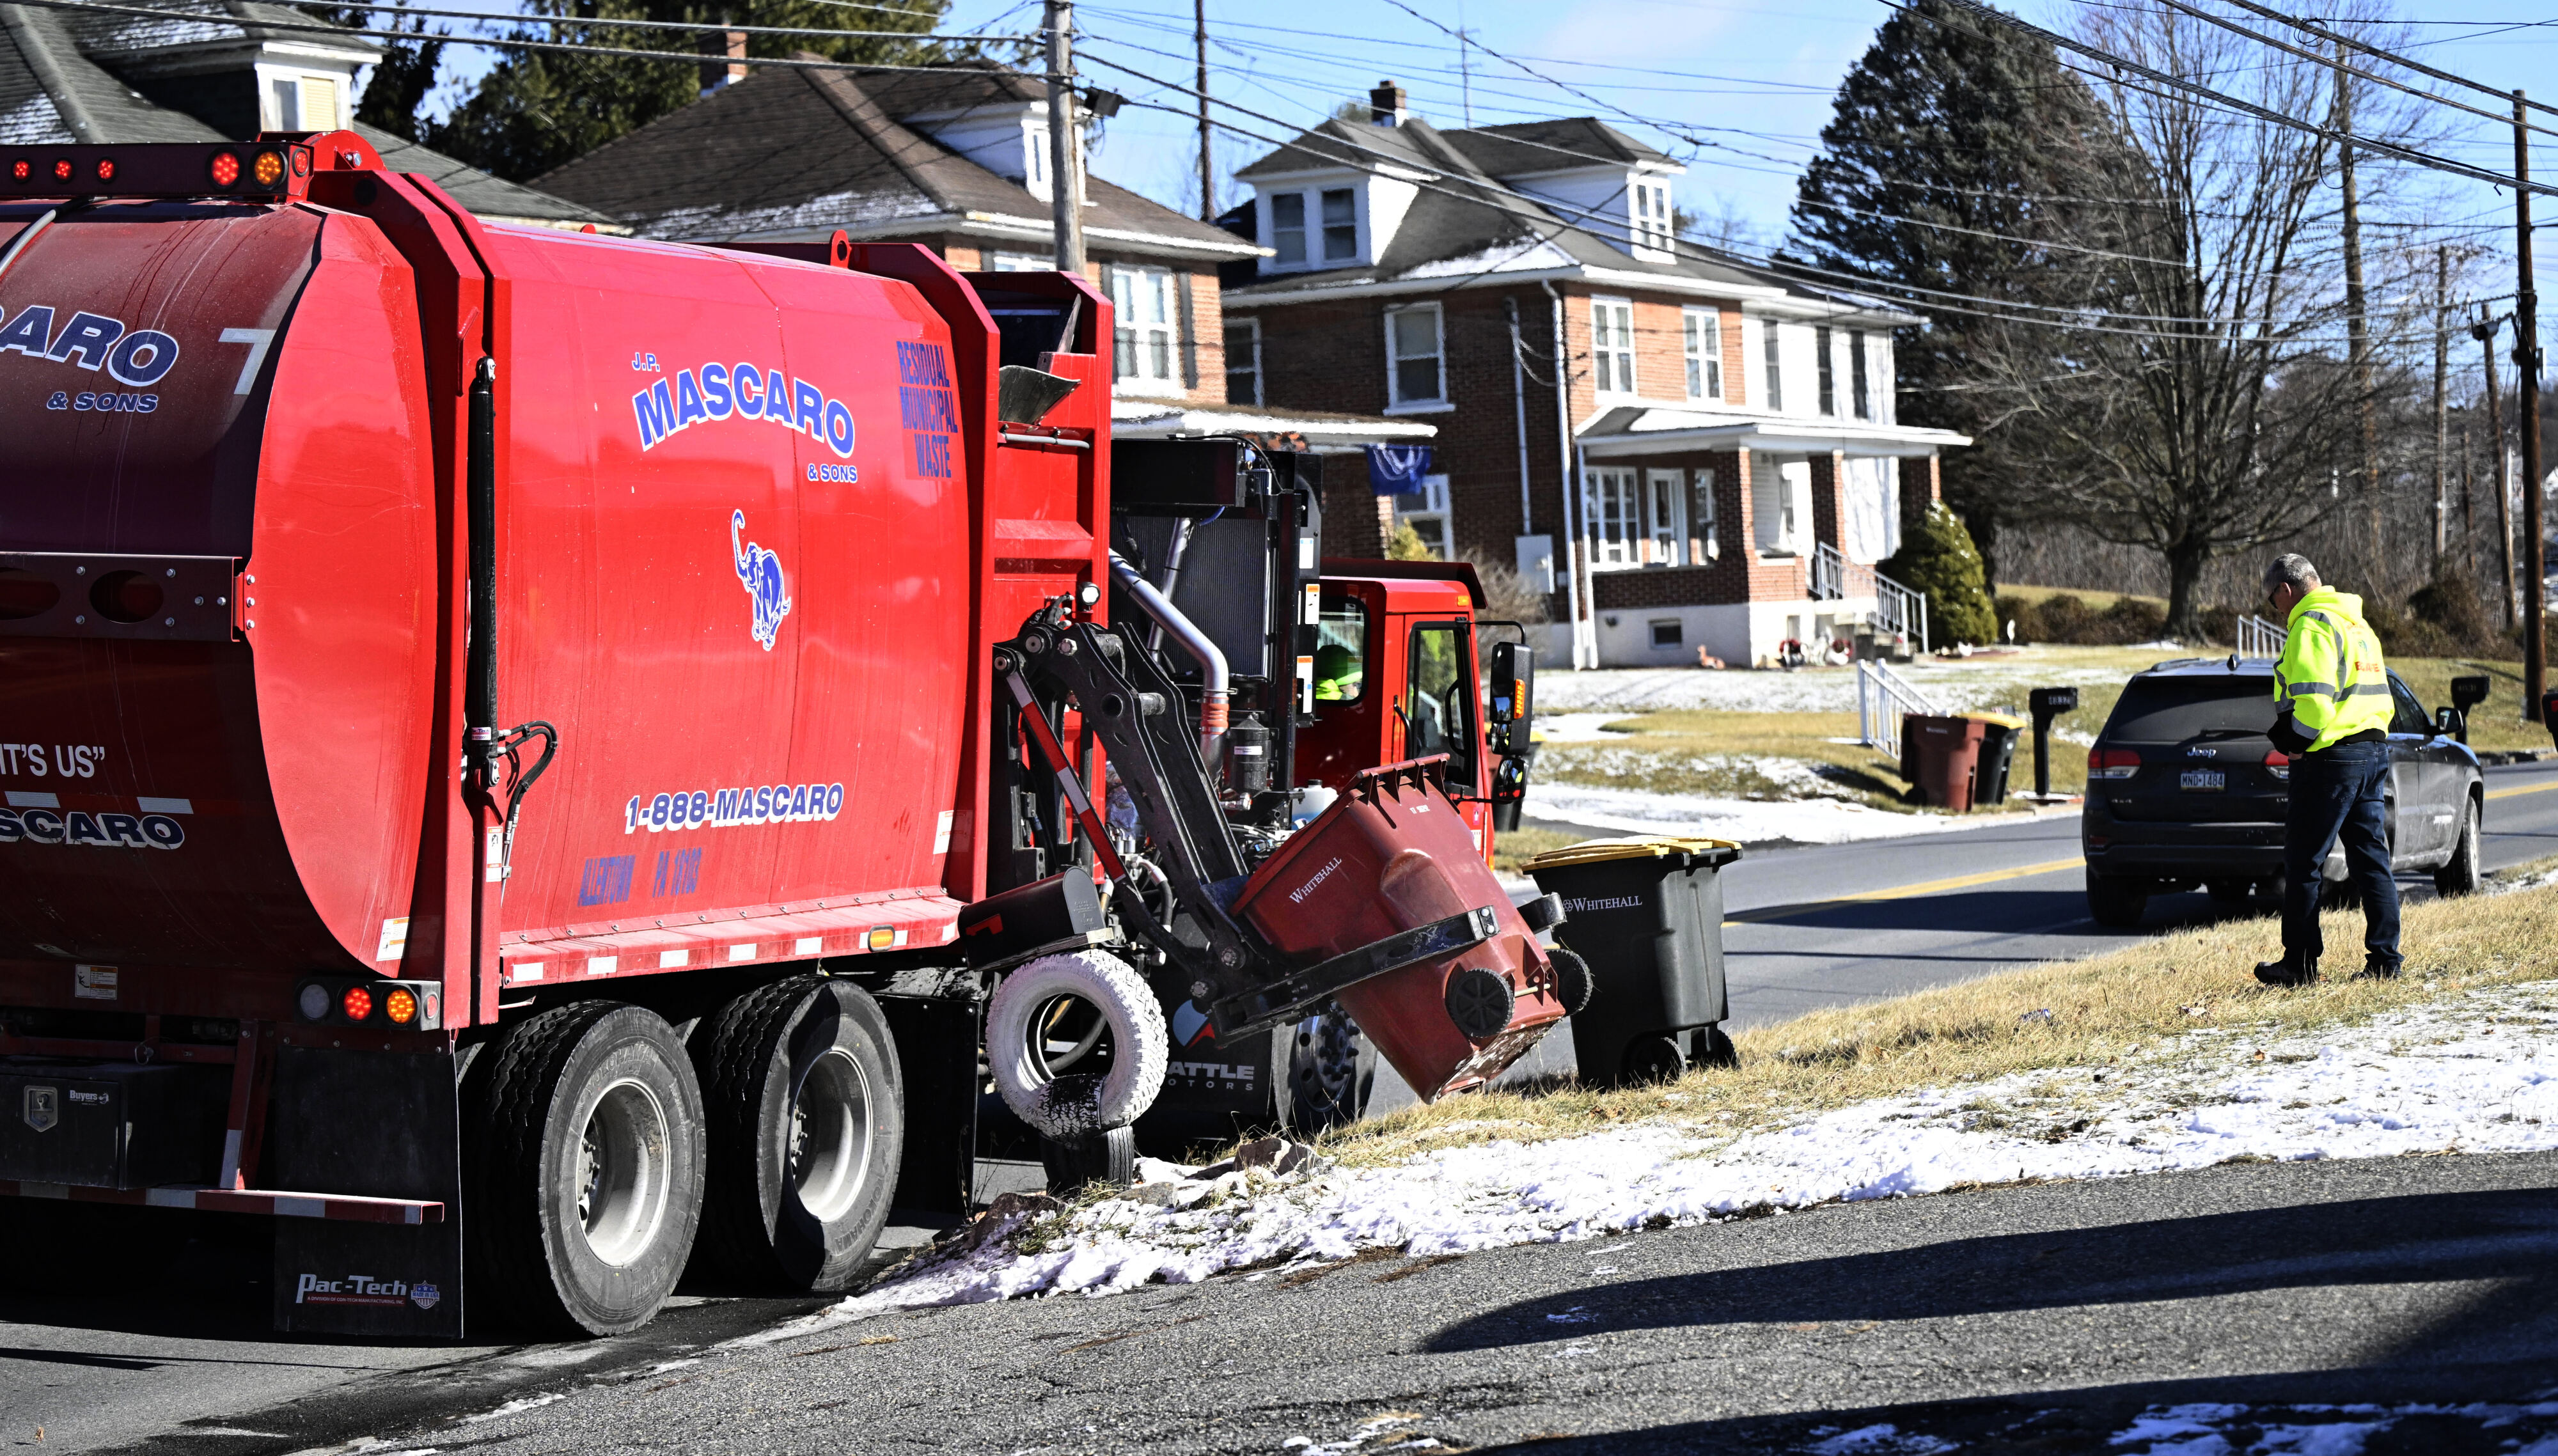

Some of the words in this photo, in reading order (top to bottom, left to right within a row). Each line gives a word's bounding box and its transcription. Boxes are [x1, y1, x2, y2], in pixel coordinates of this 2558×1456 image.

[0, 304, 180, 387] ARO
[631, 352, 661, 373] J.P.
[896, 341, 950, 387] RESIDUAL
[47, 391, 67, 411] &
[74, 392, 159, 413] SONS
[632, 361, 855, 458] MASCARO
[899, 386, 959, 434] MUNICIPAL
[914, 434, 952, 478] WASTE
[807, 463, 819, 481] &
[820, 464, 858, 483] SONS
[2187, 746, 2217, 758] Jeep
[625, 783, 844, 834] 1-888-MASCARO
[1289, 857, 1342, 904] WHITEHALL
[1572, 896, 1642, 912] WHITEHALL
[1166, 1061, 1255, 1080] ATTLE
[70, 1090, 97, 1101] Buyers
[1168, 1079, 1253, 1091] OTORS
[295, 1274, 407, 1304] Pac-Tech
